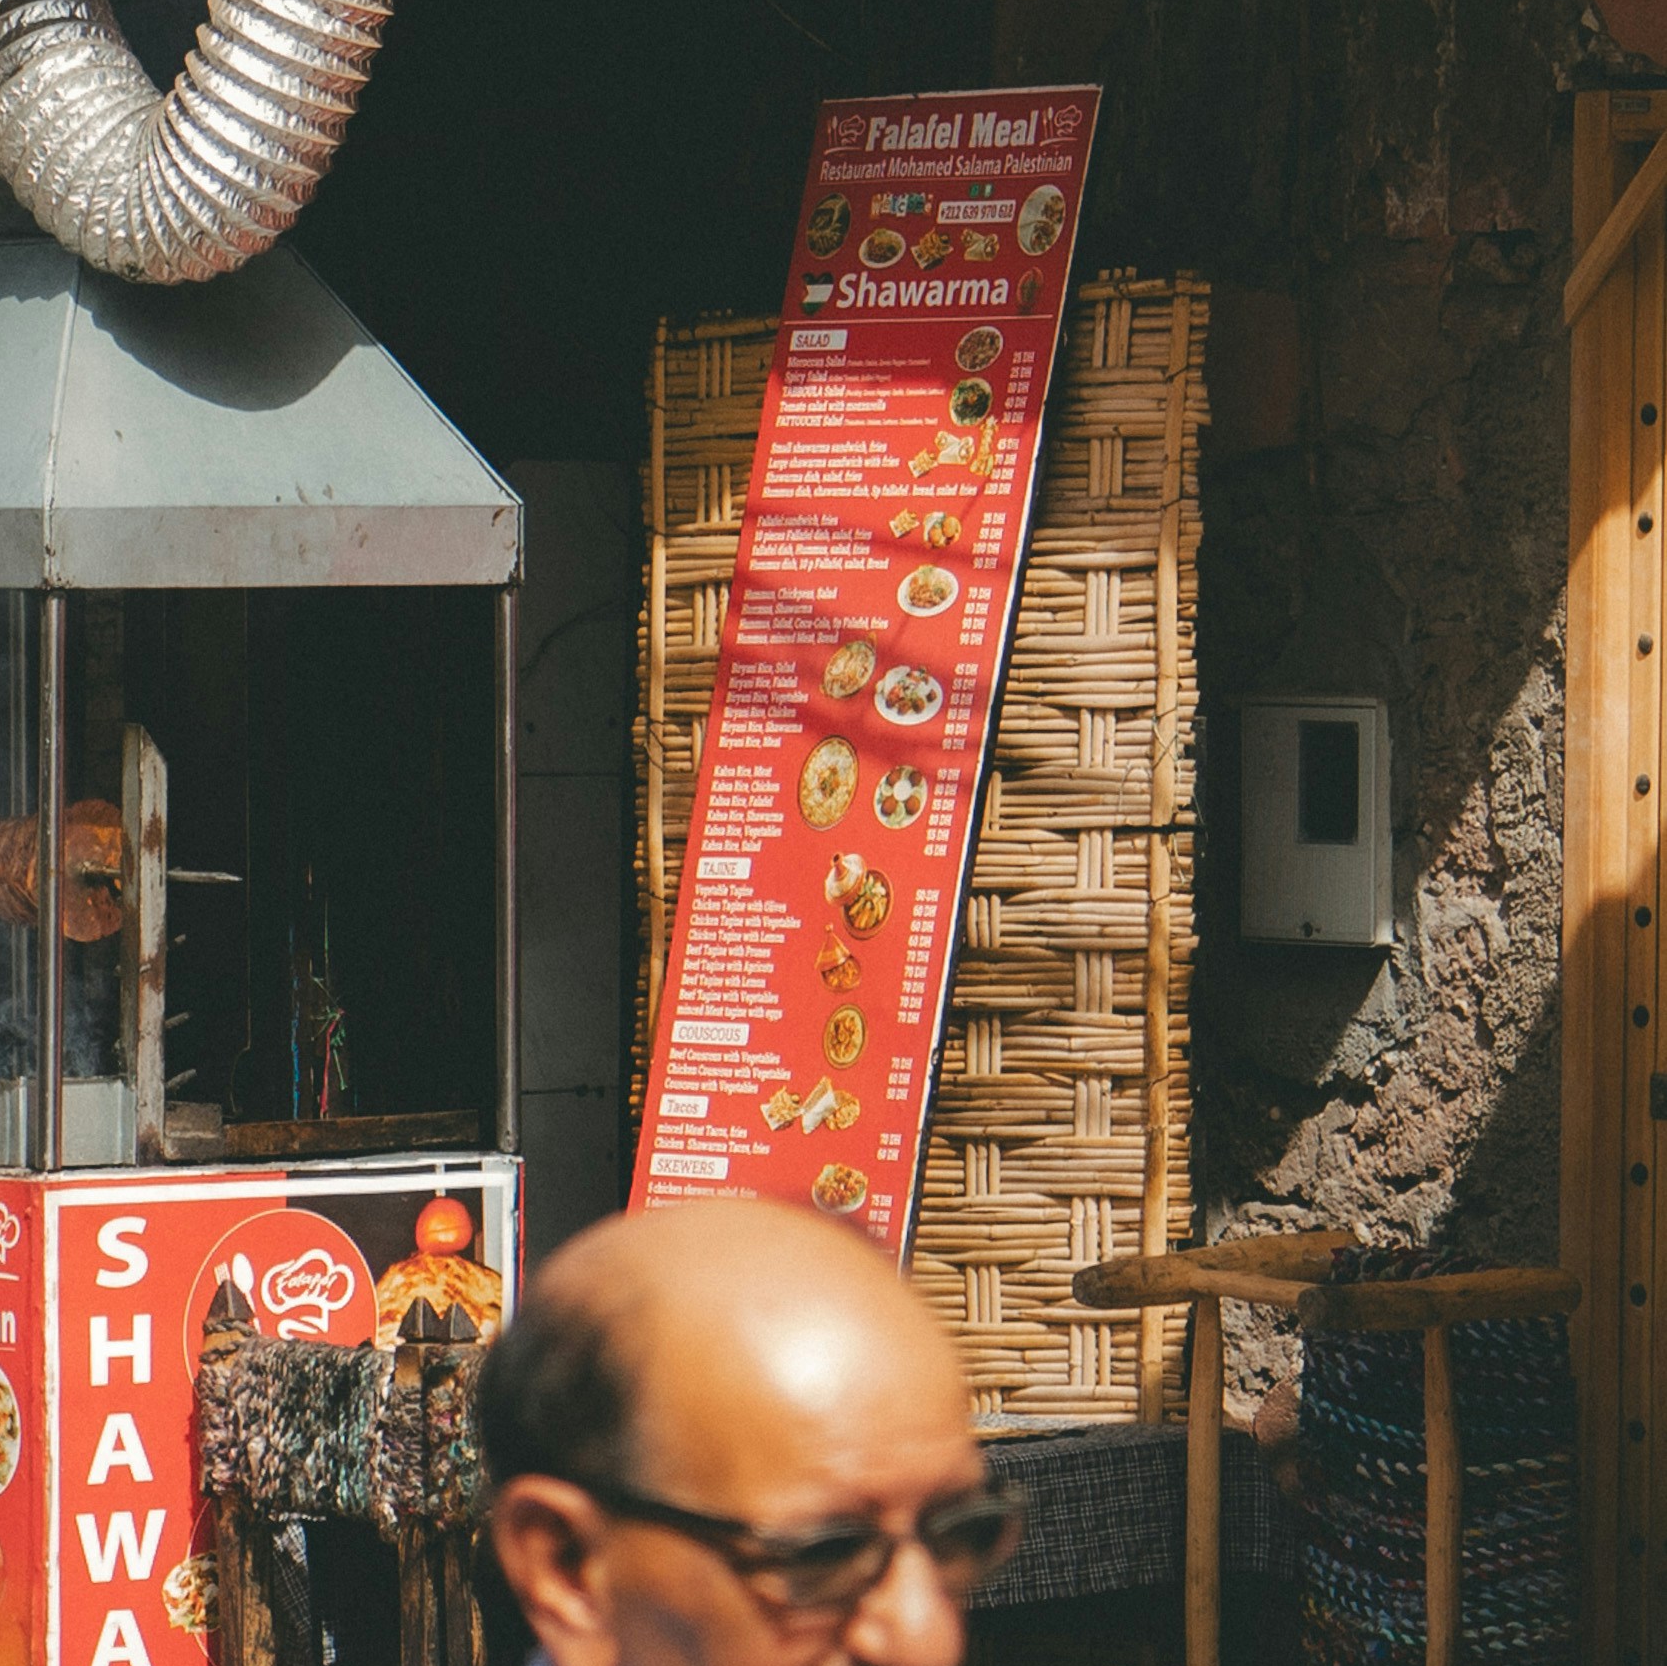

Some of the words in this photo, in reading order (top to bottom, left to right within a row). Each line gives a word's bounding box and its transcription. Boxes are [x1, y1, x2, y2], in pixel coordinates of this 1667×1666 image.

[865, 114, 963, 151] Falafel
[968, 110, 1039, 148] Meal
[820, 159, 887, 181] Restaurant
[887, 155, 954, 177] Mohamed
[954, 154, 1002, 176] Salama
[1003, 151, 1072, 174] Palestinian
[962, 205, 980, 219] 639
[981, 204, 997, 219] 970
[836, 271, 1009, 308] Shawarma
[795, 334, 830, 348] SALAD
[704, 862, 737, 876] TAJINE
[678, 1026, 741, 1042] COUSCOUS
[667, 1099, 699, 1115] Tacos
[657, 1158, 714, 1175] SKEWERS
